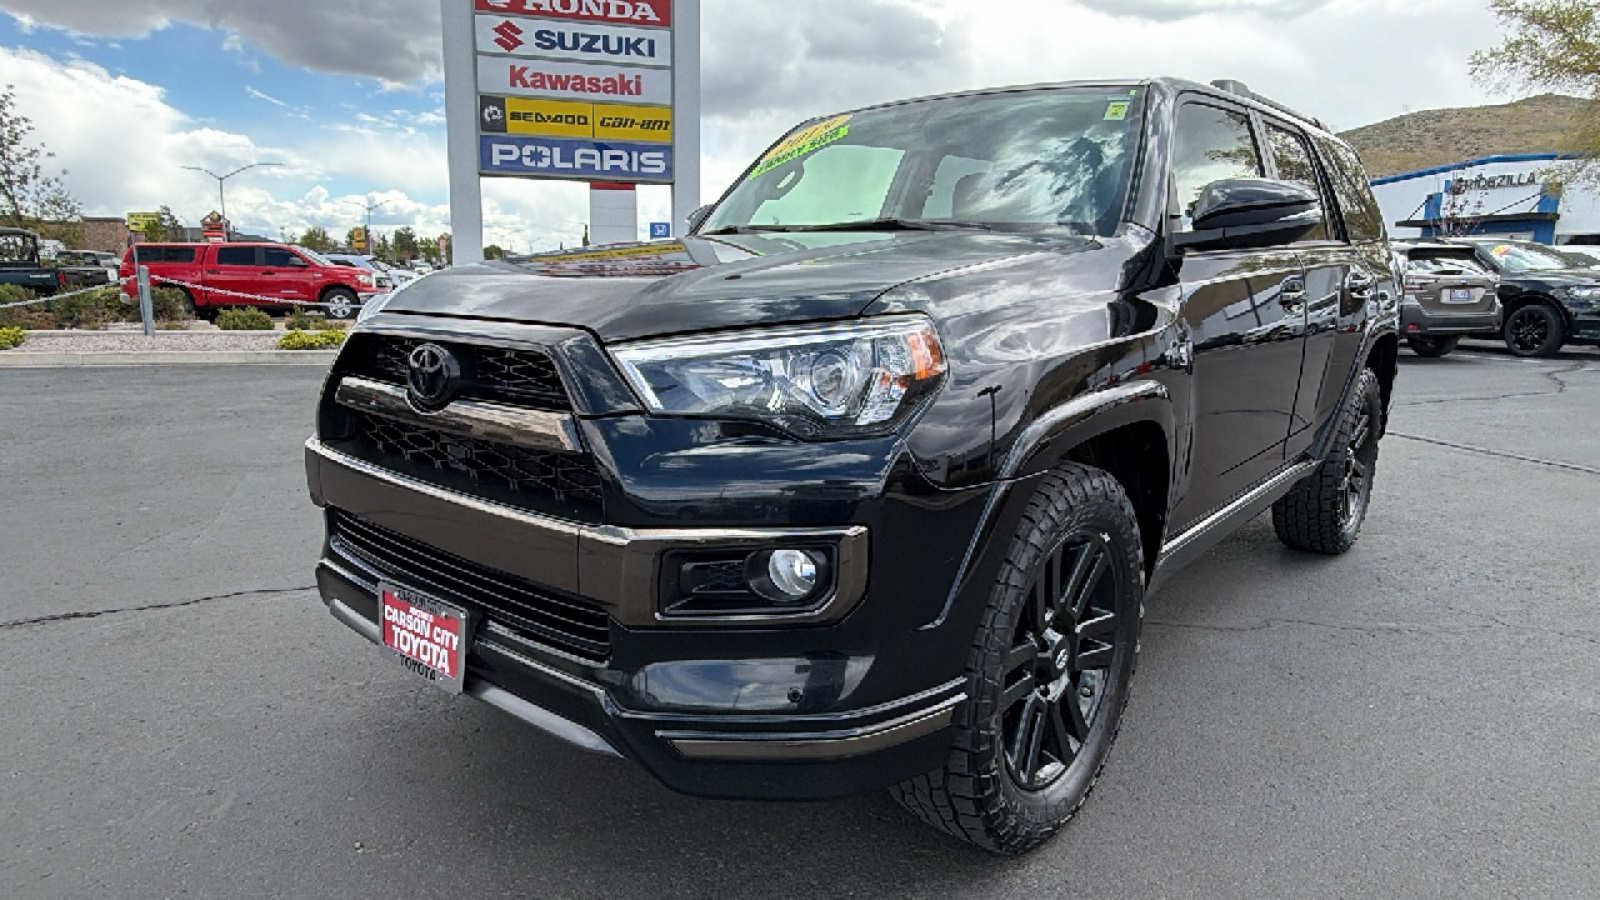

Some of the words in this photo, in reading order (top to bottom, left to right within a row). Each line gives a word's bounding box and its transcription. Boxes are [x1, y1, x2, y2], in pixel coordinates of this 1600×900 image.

[523, 0, 660, 21] HONDA
[535, 29, 655, 58] SUZUKI
[509, 64, 642, 96] Kawasaki
[491, 143, 666, 174] POLARIS
[385, 605, 430, 637] CARSON
[433, 626, 459, 650] CITY
[392, 625, 450, 675] TOYOTA
[400, 655, 436, 680] TOYOTA
